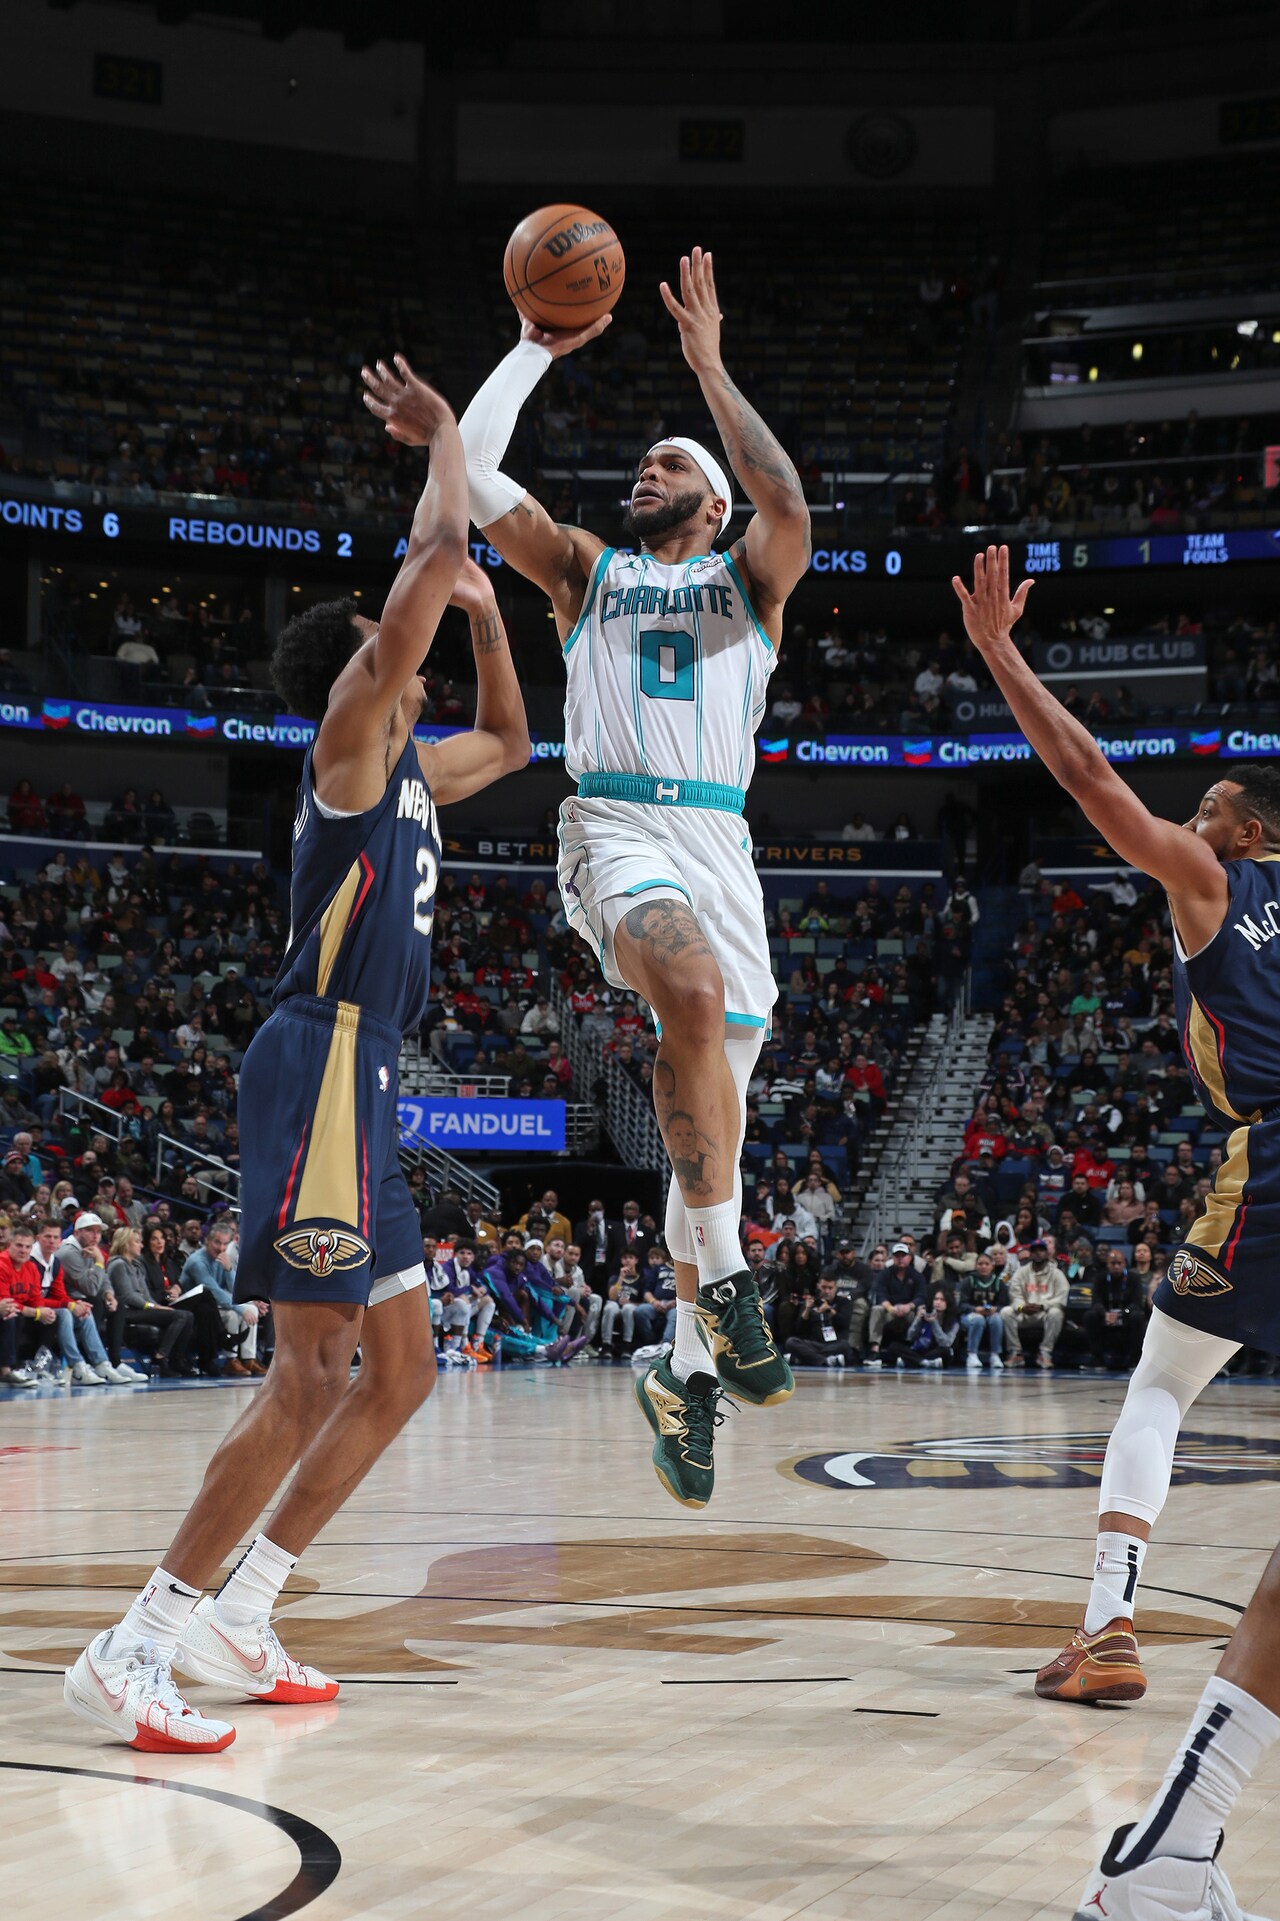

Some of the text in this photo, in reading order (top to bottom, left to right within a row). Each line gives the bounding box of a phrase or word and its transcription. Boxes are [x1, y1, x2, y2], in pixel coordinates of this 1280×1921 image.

[543, 221, 611, 258] Wilson
[0, 501, 120, 538] OINTS 6
[169, 517, 353, 558] REBOUNDS 2
[1187, 534, 1225, 549] TEAM
[1026, 542, 1060, 557] TIME
[1073, 545, 1088, 567] 5
[1139, 541, 1150, 564] 1
[1183, 548, 1229, 565] FOULS
[811, 550, 902, 575] CKS 0
[1025, 556, 1061, 572] OUTS
[601, 584, 733, 624] CHARLOTTE
[1079, 641, 1195, 663] HUB CLUB
[640, 630, 694, 701] 0
[76, 708, 171, 735] Chevron
[223, 718, 315, 744] Chevron
[796, 740, 889, 762] Chevron
[939, 742, 1031, 762] Chevron
[1096, 736, 1176, 756] hevron
[478, 840, 554, 857] BETRI
[754, 846, 862, 862] TRIVERS
[430, 1112, 552, 1136] FANDUEL
